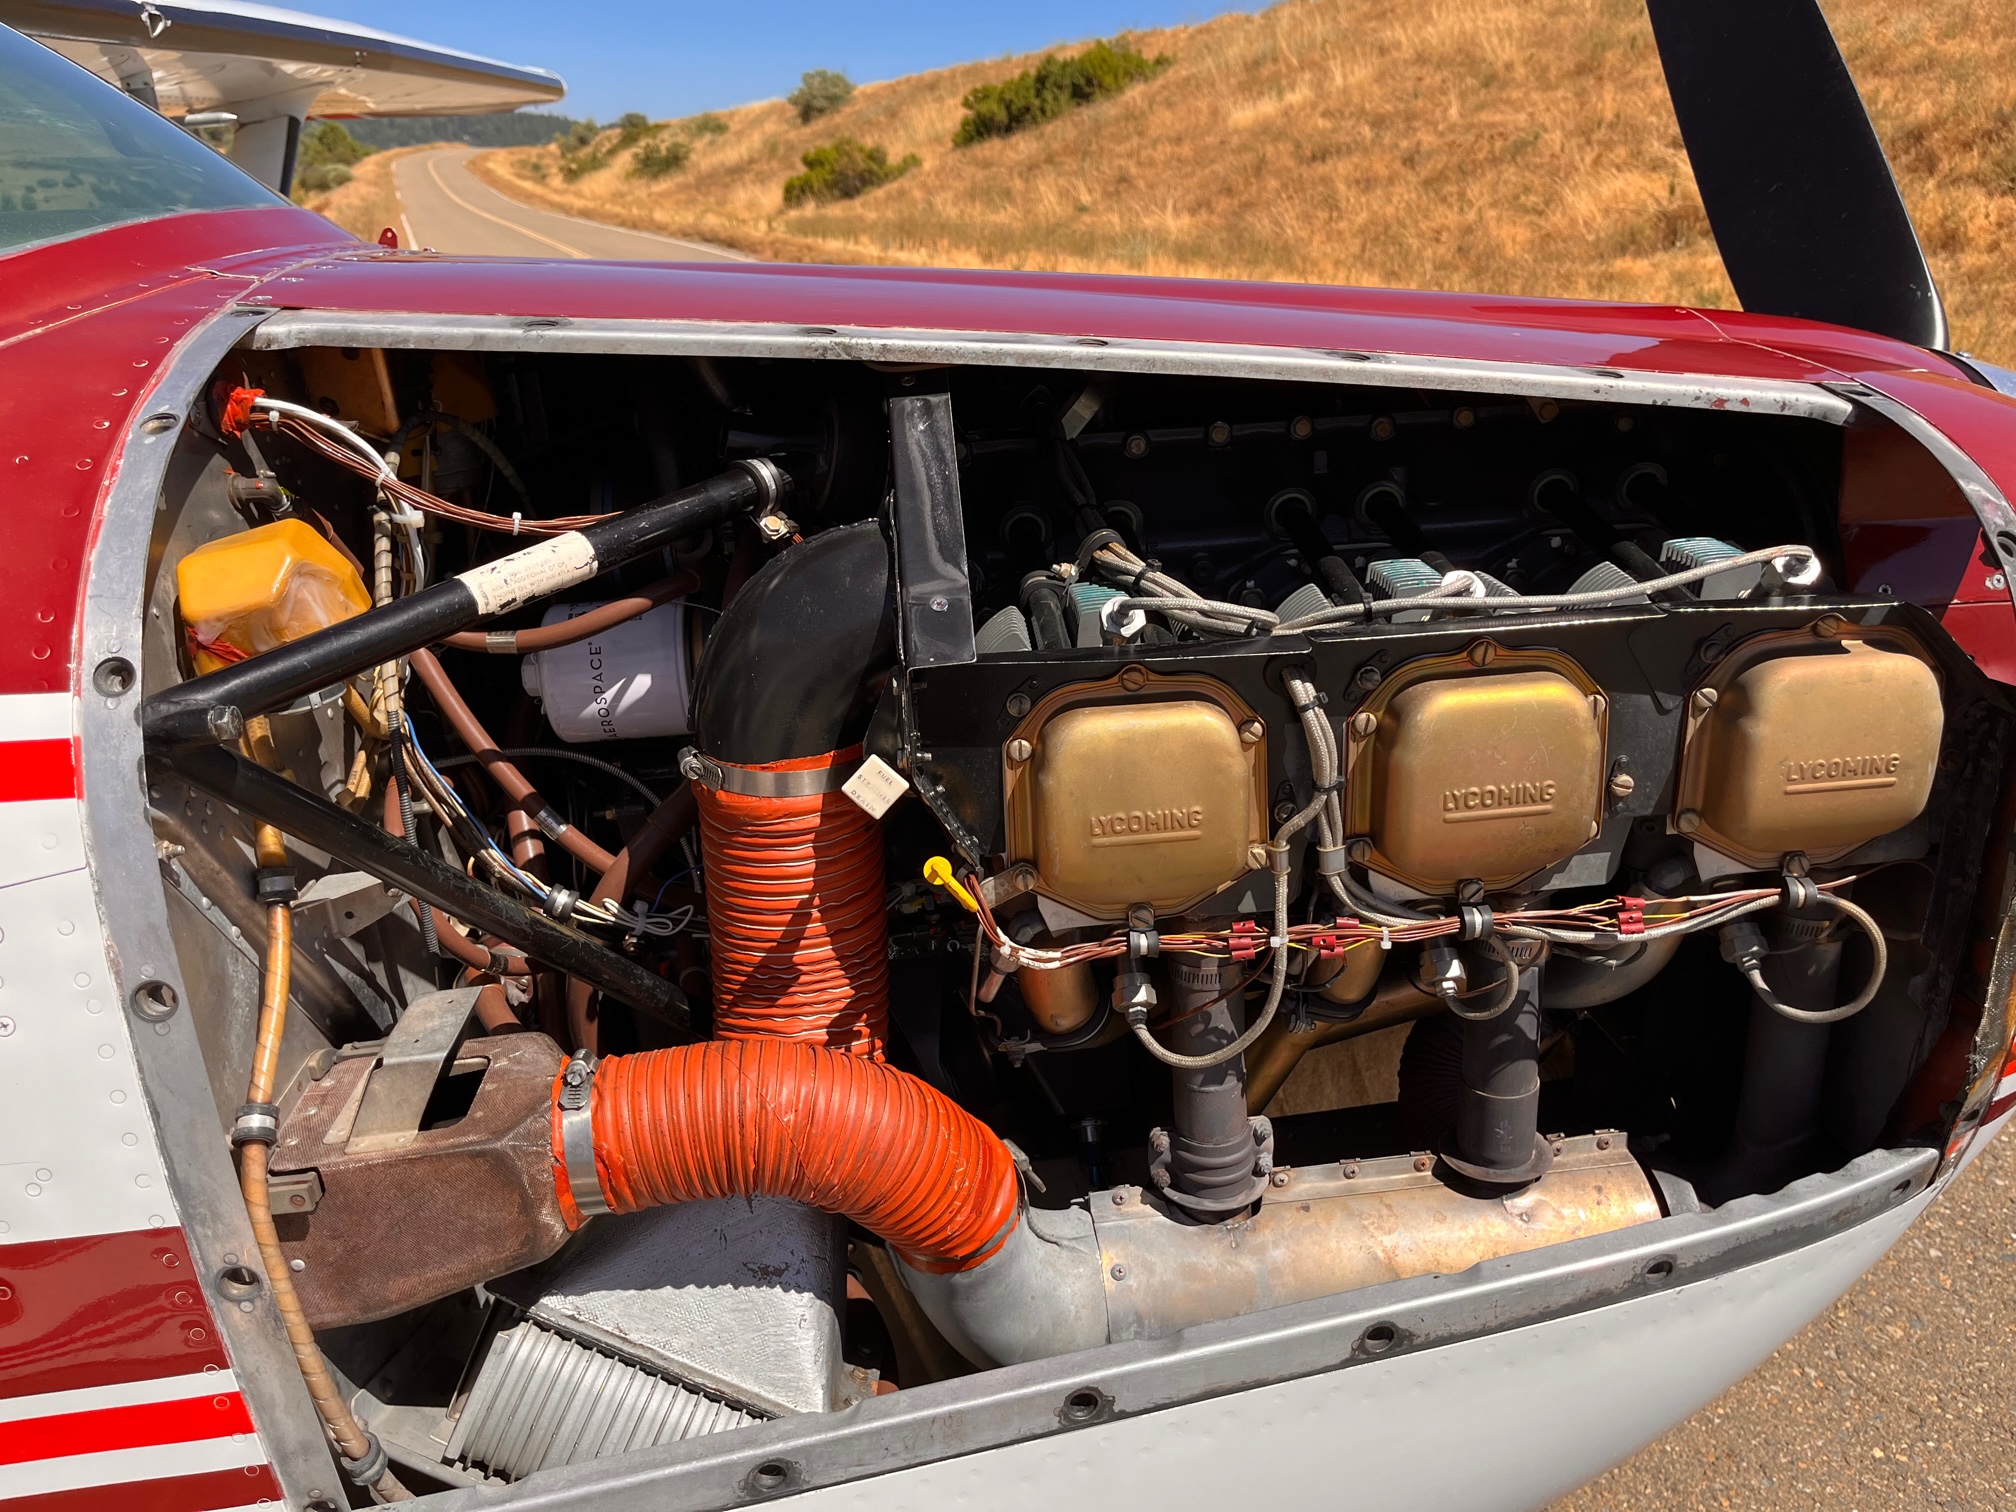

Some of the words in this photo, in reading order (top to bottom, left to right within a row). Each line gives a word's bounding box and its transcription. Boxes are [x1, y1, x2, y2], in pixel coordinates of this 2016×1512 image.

[589, 645, 619, 738] AEROSPACE
[877, 769, 893, 786] FUEL
[1785, 752, 1900, 782] LYCOMING
[850, 789, 877, 812] DRAIN
[1442, 780, 1556, 812] LYCOMING
[1089, 805, 1203, 837] LYCOMING
